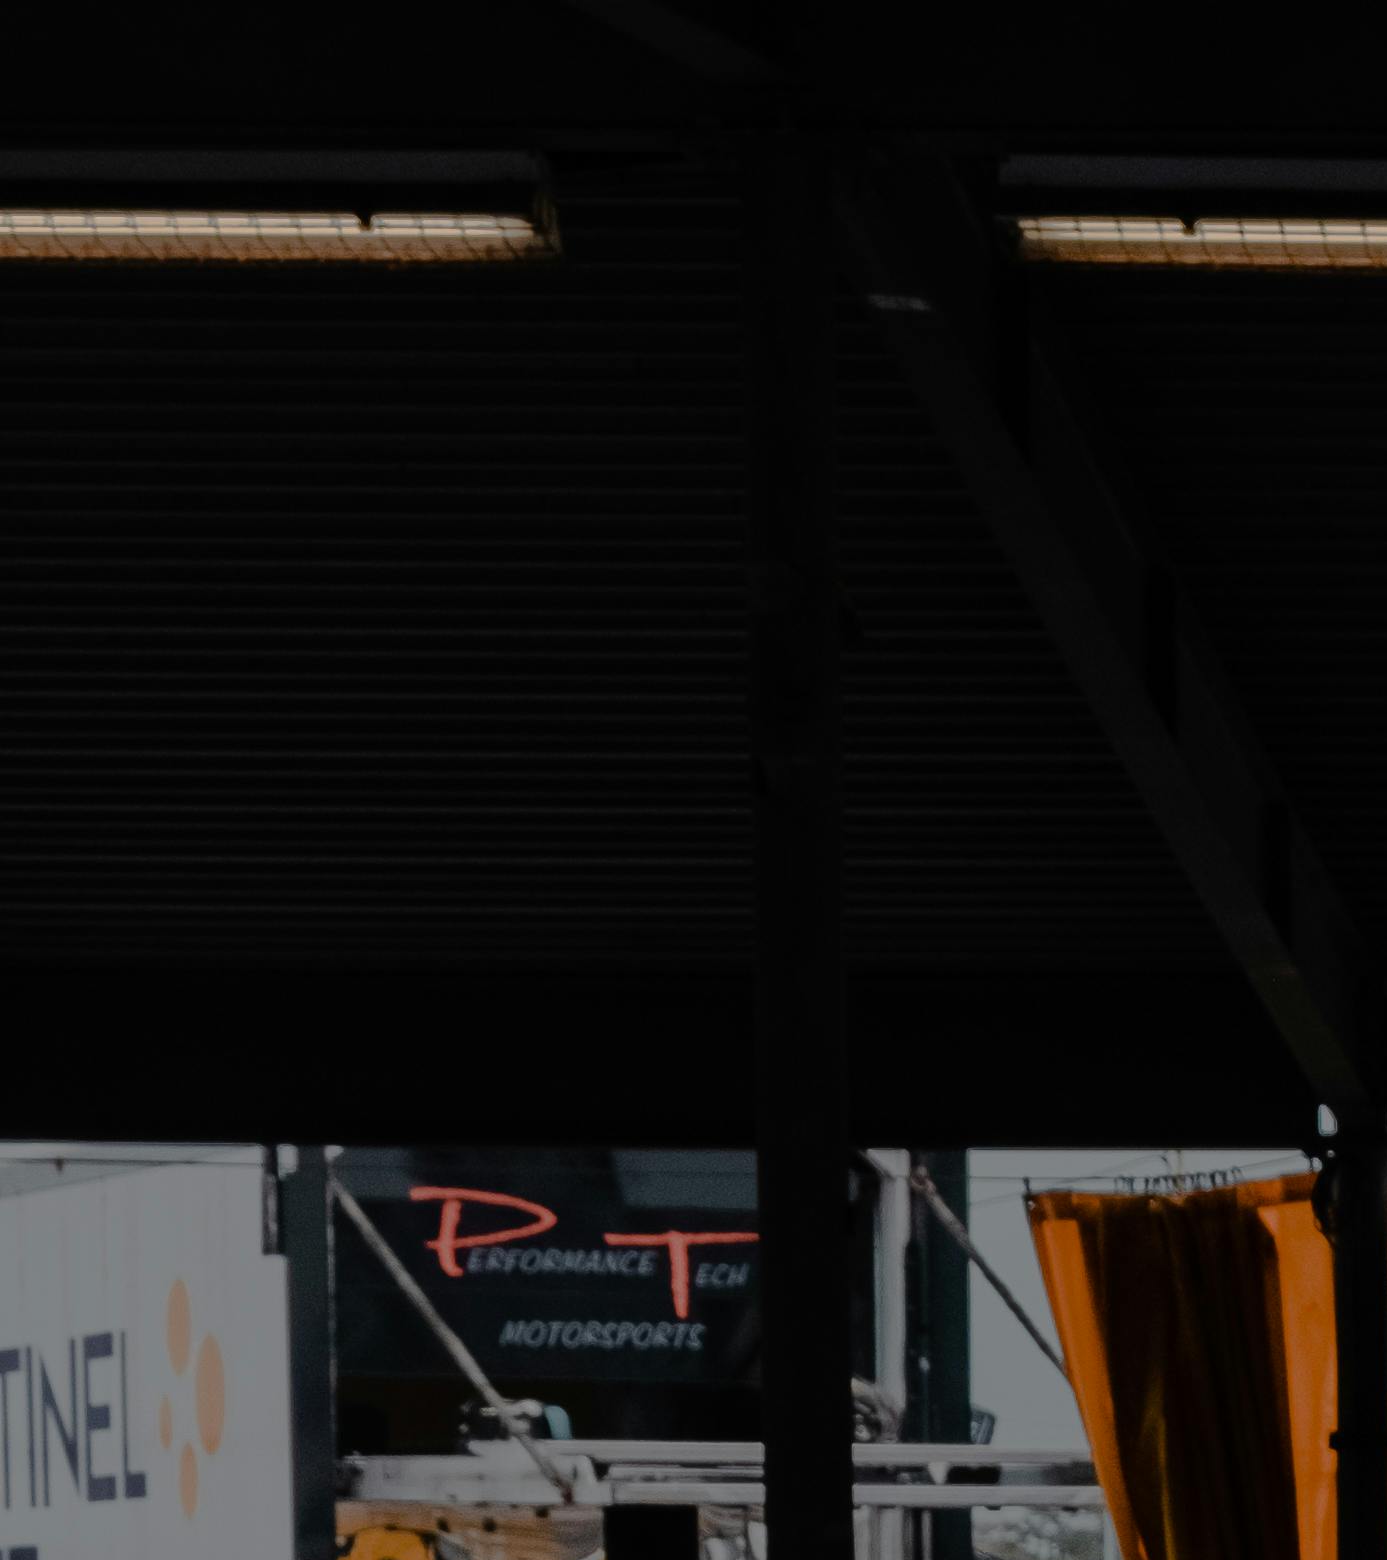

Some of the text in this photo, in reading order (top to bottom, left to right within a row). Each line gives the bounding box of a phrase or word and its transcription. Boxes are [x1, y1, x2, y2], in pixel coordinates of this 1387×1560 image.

[409, 1186, 760, 1319] PERFORMANCE TECH
[499, 1320, 707, 1349] MOTORSPORTS
